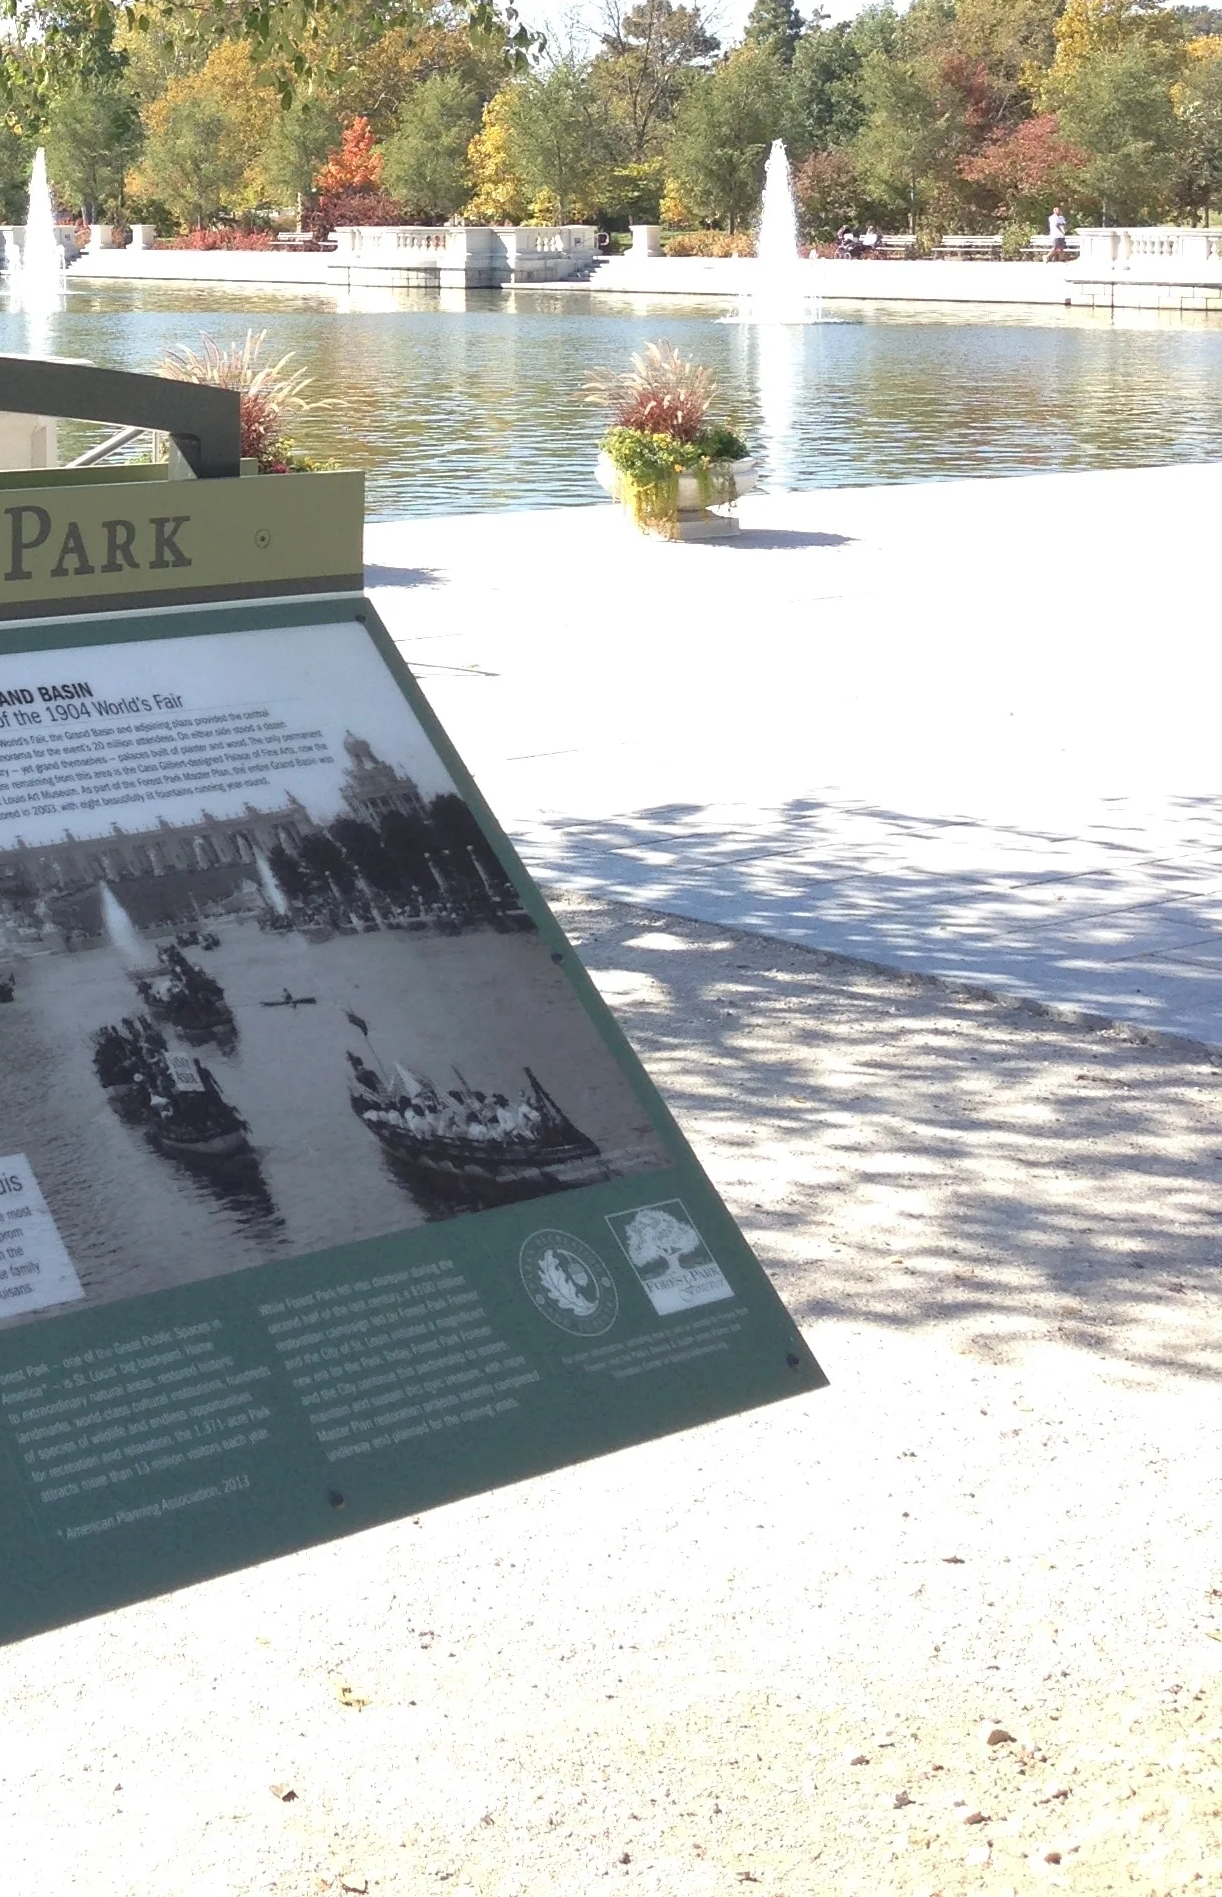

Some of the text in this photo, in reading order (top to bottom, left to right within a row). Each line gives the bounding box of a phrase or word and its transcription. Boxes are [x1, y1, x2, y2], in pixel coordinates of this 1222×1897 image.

[37, 682, 93, 702] BASIN
[12, 709, 42, 726] the
[45, 701, 91, 722] 1904
[91, 696, 152, 716] World's
[152, 693, 183, 710] Fair
[6, 1205, 32, 1219] most
